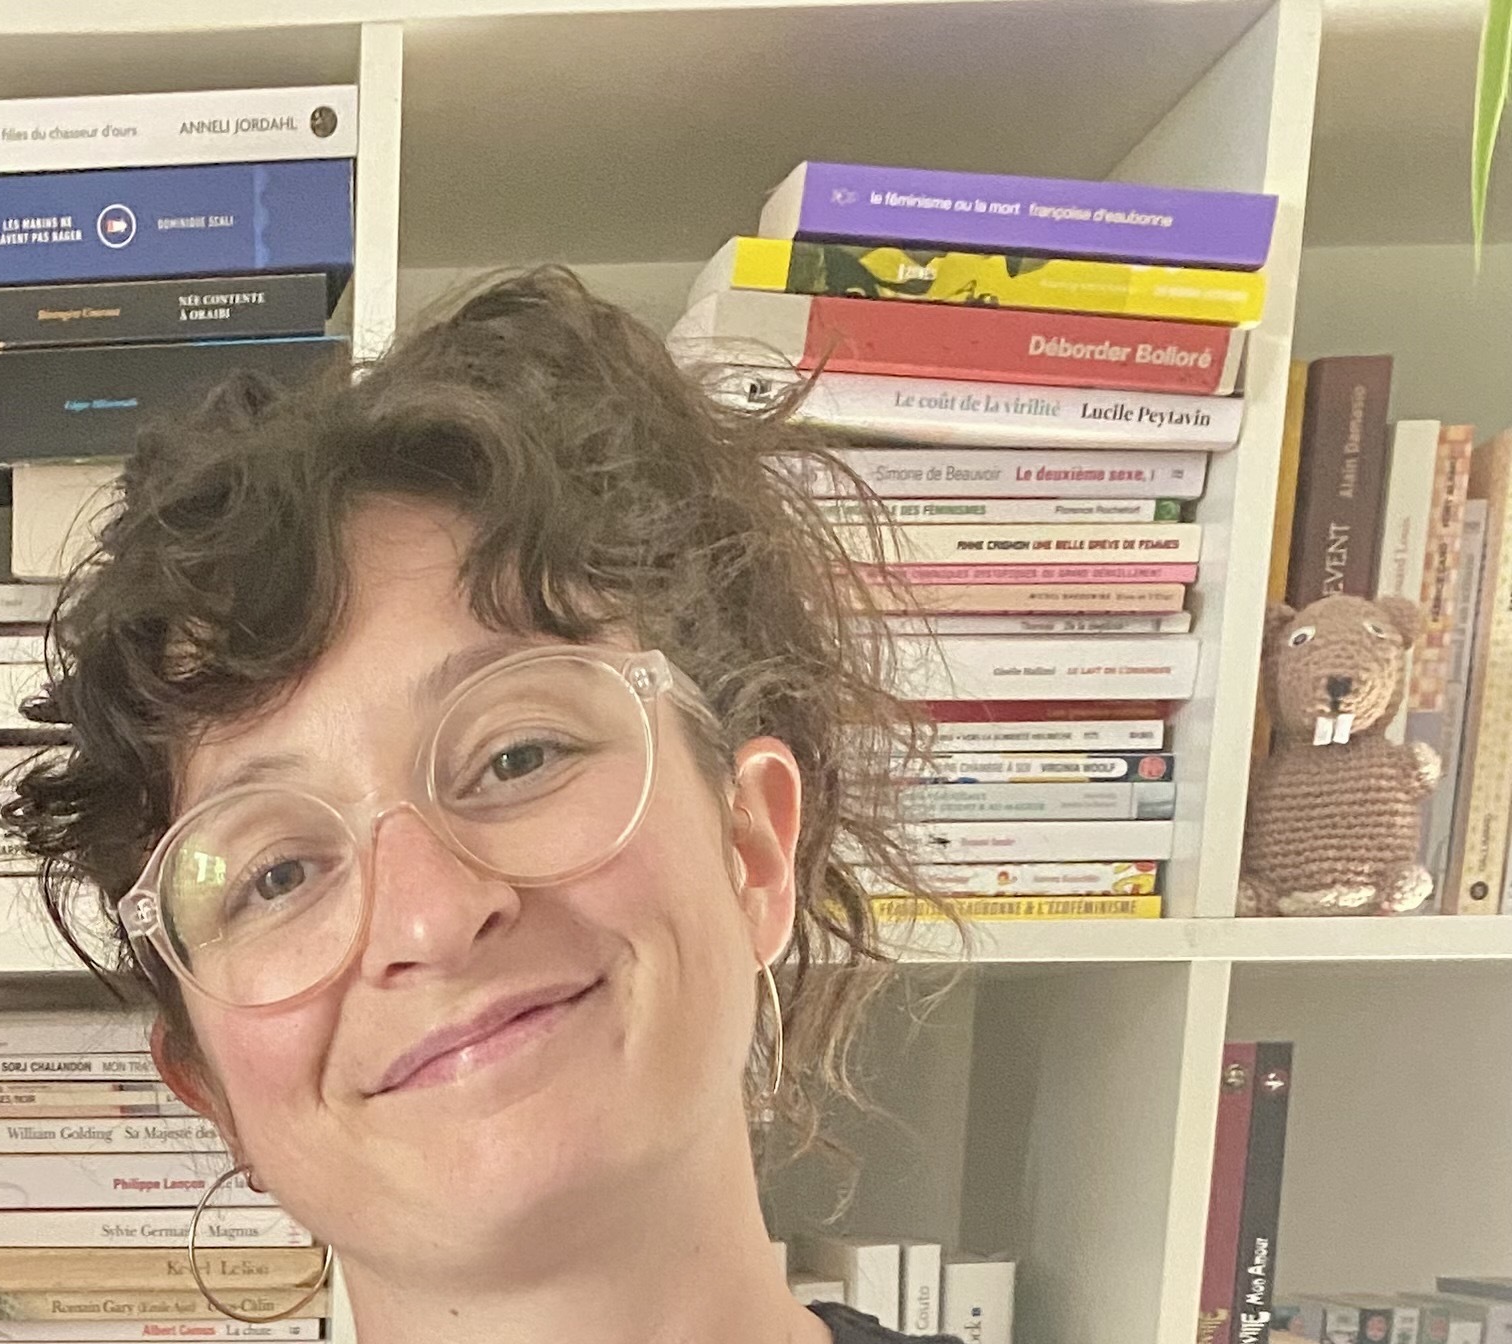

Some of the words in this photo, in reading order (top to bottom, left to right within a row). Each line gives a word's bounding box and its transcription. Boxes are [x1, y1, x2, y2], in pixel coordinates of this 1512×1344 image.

[32, 127, 46, 140] du
[179, 118, 230, 136] ANNELI
[232, 114, 299, 135] JORDAHL
[884, 193, 953, 212] féminisme
[989, 201, 1021, 216] mort
[31, 230, 50, 243] PAS
[1029, 335, 1131, 363] Déborder
[895, 391, 921, 413] Le
[924, 391, 960, 414] coût
[963, 392, 984, 414] de
[1081, 399, 1134, 424] Lucile
[1137, 405, 1212, 431] Peytavin
[875, 466, 923, 482] Simone
[926, 465, 942, 481] de
[945, 465, 1002, 482] Beauvoir
[1016, 466, 1033, 481] Le
[30, 1060, 93, 1073] CHALANDON
[7, 1125, 56, 1141] William
[59, 1125, 113, 1143] Golding
[112, 1177, 161, 1192] Philippe
[101, 1224, 138, 1240] Sylvie
[52, 1299, 101, 1314] Romain
[103, 1300, 135, 1318] Gary
[915, 1285, 930, 1331] Couto
